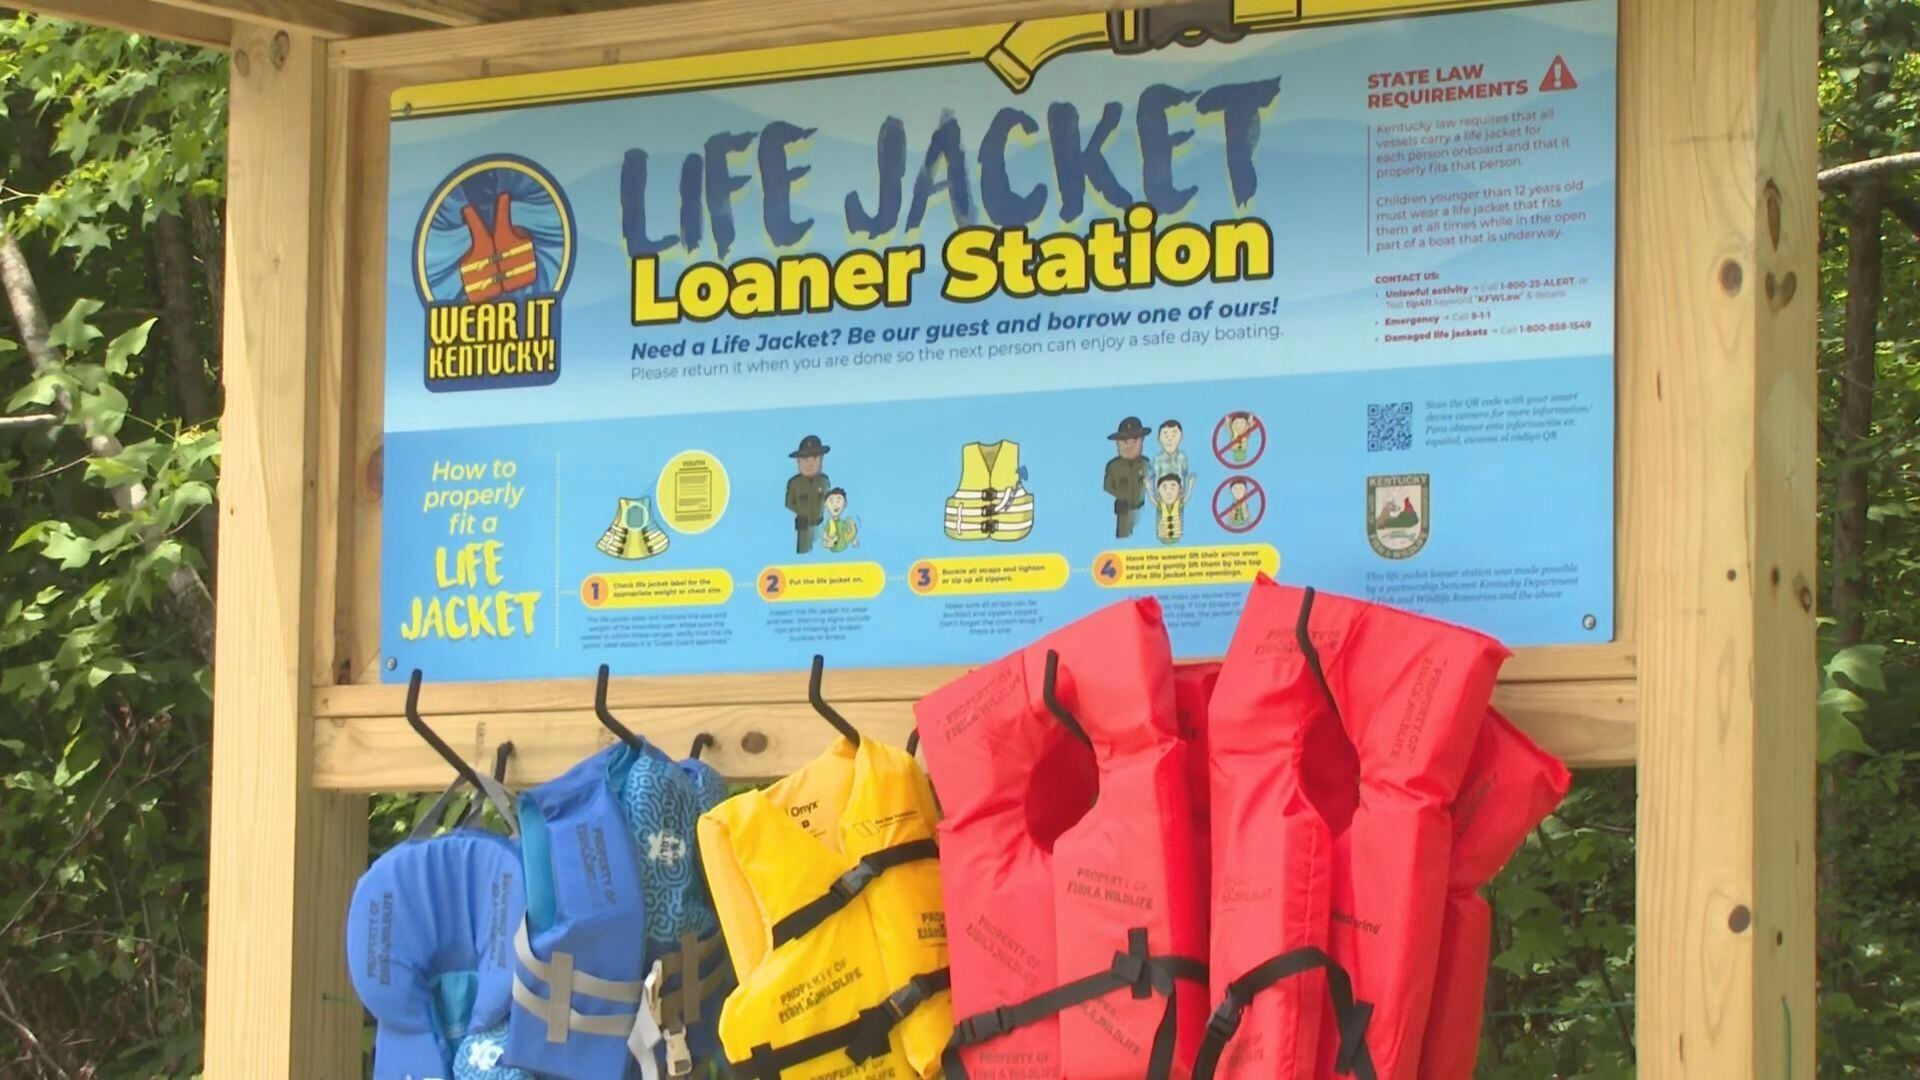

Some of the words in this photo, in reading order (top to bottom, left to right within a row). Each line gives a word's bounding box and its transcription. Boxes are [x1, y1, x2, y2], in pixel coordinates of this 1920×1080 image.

[1367, 69, 1430, 88] STATE
[1436, 64, 1483, 83] LAW
[1367, 80, 1528, 108] REQUIREMENTS
[1376, 120, 1432, 133] Kentucky
[1436, 119, 1456, 128] law
[1459, 115, 1509, 128] requires
[1511, 111, 1536, 122] that
[1540, 110, 1554, 120] all
[1376, 136, 1418, 147] vessels
[1421, 134, 1451, 145] carry
[1463, 130, 1482, 140] life
[1484, 127, 1521, 141] jacket
[1524, 126, 1541, 136] for
[1376, 151, 1404, 162] each
[1407, 149, 1448, 163] person
[1451, 143, 1502, 156] onboard
[1505, 141, 1529, 152] and
[1532, 139, 1557, 150] that
[1560, 138, 1569, 148] it
[620, 120, 818, 261] LIFE
[844, 75, 1282, 239] JACKET
[1376, 164, 1425, 179] properly
[1428, 162, 1448, 172] fits
[1450, 160, 1475, 170] that
[1376, 195, 1426, 206] Children
[1429, 191, 1479, 205] younger
[1482, 188, 1511, 198] than
[1514, 186, 1525, 196] 12
[1528, 185, 1561, 197] years
[1563, 181, 1583, 192] old
[1376, 209, 1406, 220] must
[1410, 209, 1438, 218] wear
[1442, 208, 1449, 216] a
[1452, 205, 1470, 215] life
[1472, 202, 1509, 216] jacket
[1512, 200, 1538, 210] that
[1541, 198, 1562, 208] fits
[1376, 225, 1408, 235] them
[1411, 222, 1423, 232] at
[1426, 221, 1440, 231] all
[1442, 220, 1477, 230] times
[1480, 216, 1512, 227] while
[1516, 215, 1527, 224] in
[1530, 213, 1551, 223] the
[1554, 212, 1586, 224] open
[1376, 238, 1400, 251] part
[1403, 237, 1415, 247] of
[1418, 238, 1425, 246] a
[1428, 234, 1456, 245] boat
[1458, 232, 1483, 243] that
[1487, 232, 1497, 241] is
[632, 245, 926, 327] Loaner
[942, 202, 1273, 302] Station
[1375, 273, 1420, 283] CONTACT
[1385, 287, 1428, 297] Unlawful
[1431, 284, 1468, 294] activity
[430, 301, 518, 344] WEAR
[526, 298, 555, 338] IT
[630, 340, 686, 359] Need
[691, 343, 704, 355] a
[711, 336, 750, 354] Life
[755, 329, 841, 351] Jacket?
[847, 327, 876, 344] Be
[881, 328, 920, 342] our
[925, 319, 989, 343] guest
[996, 314, 1041, 333] and
[1047, 312, 1131, 330] borrow
[1137, 309, 1181, 323] one
[1187, 302, 1213, 320] of
[1218, 298, 1279, 318] ours!
[1384, 316, 1439, 326] Emergency
[1470, 311, 1491, 320] 9-1-1
[1384, 331, 1431, 342] Damaged
[1433, 330, 1448, 338] life
[1451, 328, 1488, 339] jackets
[429, 338, 555, 379] KENTUCKY!
[631, 365, 678, 380] Please
[682, 361, 728, 376] return
[732, 359, 742, 373] it
[745, 357, 788, 372] when
[792, 357, 821, 372] you
[825, 355, 848, 367] are
[852, 351, 892, 365] done
[896, 351, 914, 362] so
[919, 346, 944, 360] the
[949, 343, 984, 358] next
[988, 341, 1042, 358] person
[1046, 339, 1076, 351] can
[1080, 334, 1124, 351] enjoy
[1129, 335, 1138, 345] a
[1141, 330, 1175, 345] safe
[1179, 328, 1209, 345] day
[1214, 324, 1283, 340] boating.
[432, 461, 486, 481] How
[493, 459, 517, 479] to
[424, 481, 525, 513] properly
[449, 513, 477, 536] fit
[482, 517, 497, 533] a
[435, 539, 504, 590] LIFE
[1101, 559, 1117, 579] 4
[1162, 562, 1186, 570] gently
[766, 575, 779, 592] 2
[828, 577, 850, 585] jacket
[918, 568, 930, 586] 3
[591, 583, 599, 600] 1
[401, 591, 541, 641] JACKET
[791, 801, 818, 817] Onyx
[780, 967, 832, 1006] PROPERTY
[834, 957, 846, 973] OF
